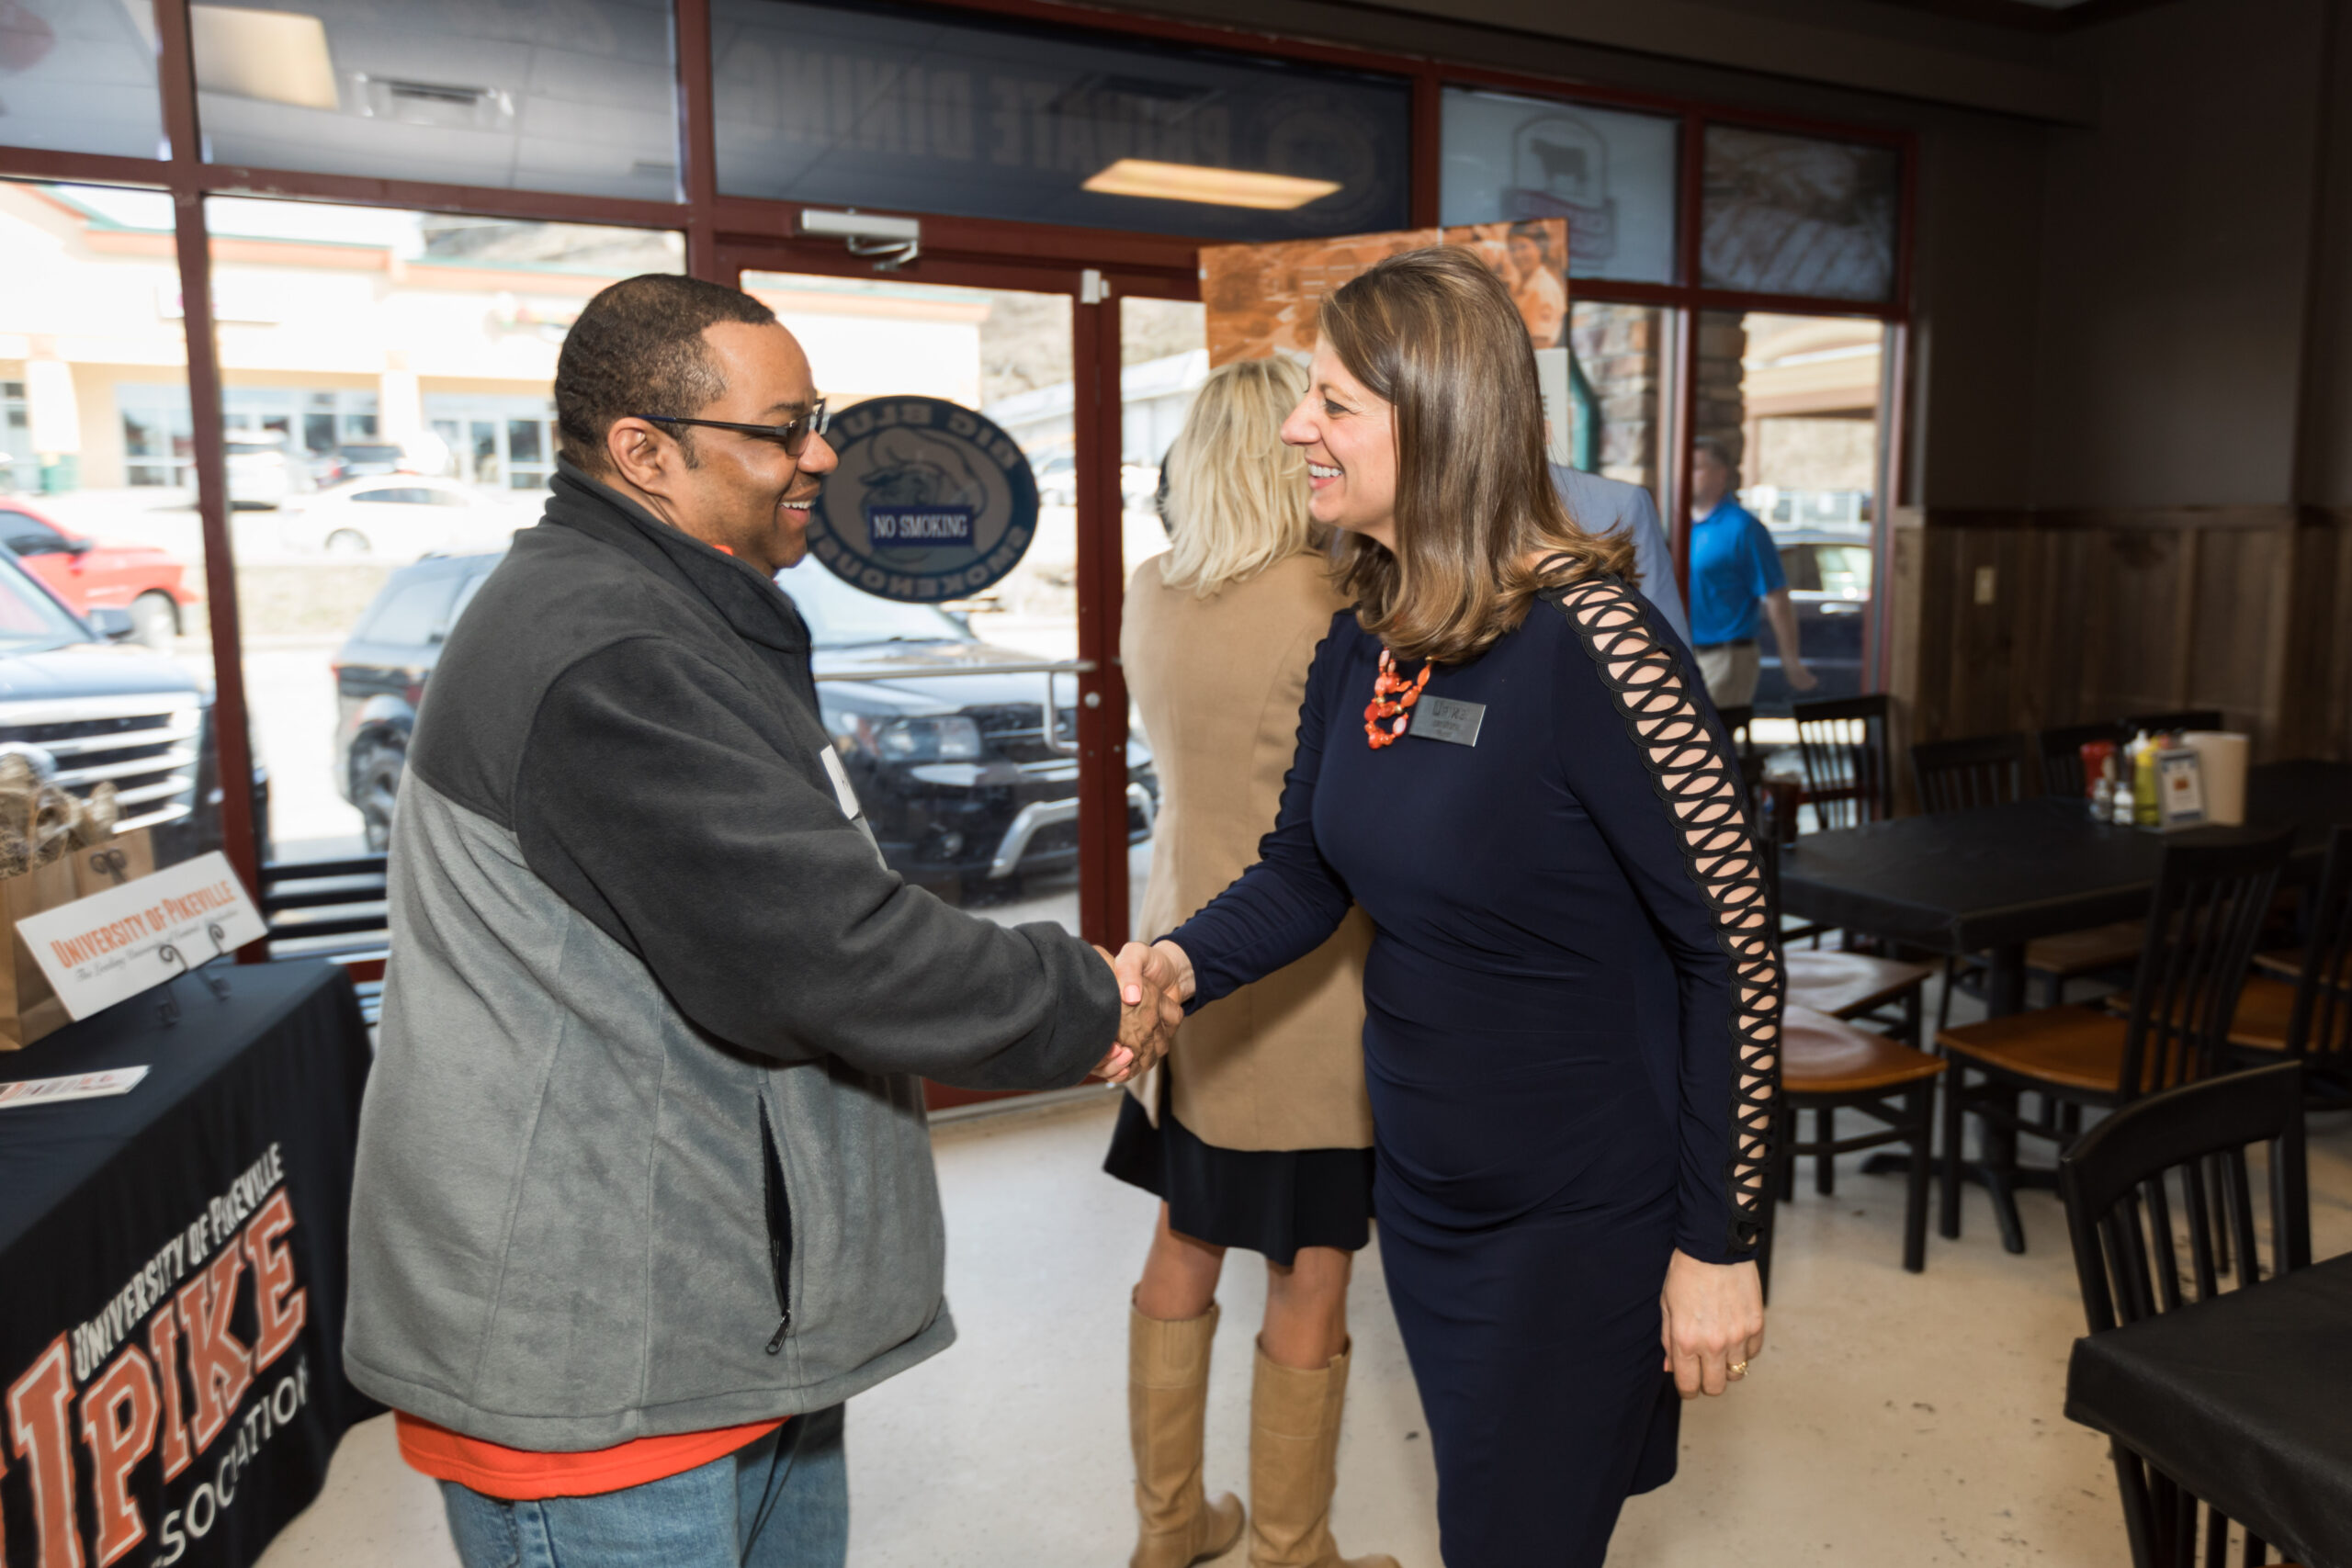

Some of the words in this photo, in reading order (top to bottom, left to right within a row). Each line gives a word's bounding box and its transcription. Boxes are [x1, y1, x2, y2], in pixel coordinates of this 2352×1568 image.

[874, 514, 897, 539] NO
[899, 514, 967, 539] SMOKING
[51, 915, 148, 967] UNIVERSITY
[146, 908, 167, 931] OF
[163, 881, 236, 921] PIKEVILLE
[73, 1232, 186, 1382] UNIVERSITY
[187, 1213, 211, 1265] OF
[208, 1142, 285, 1245] PIKEVILLE
[148, 1354, 310, 1568] SOCIATION
